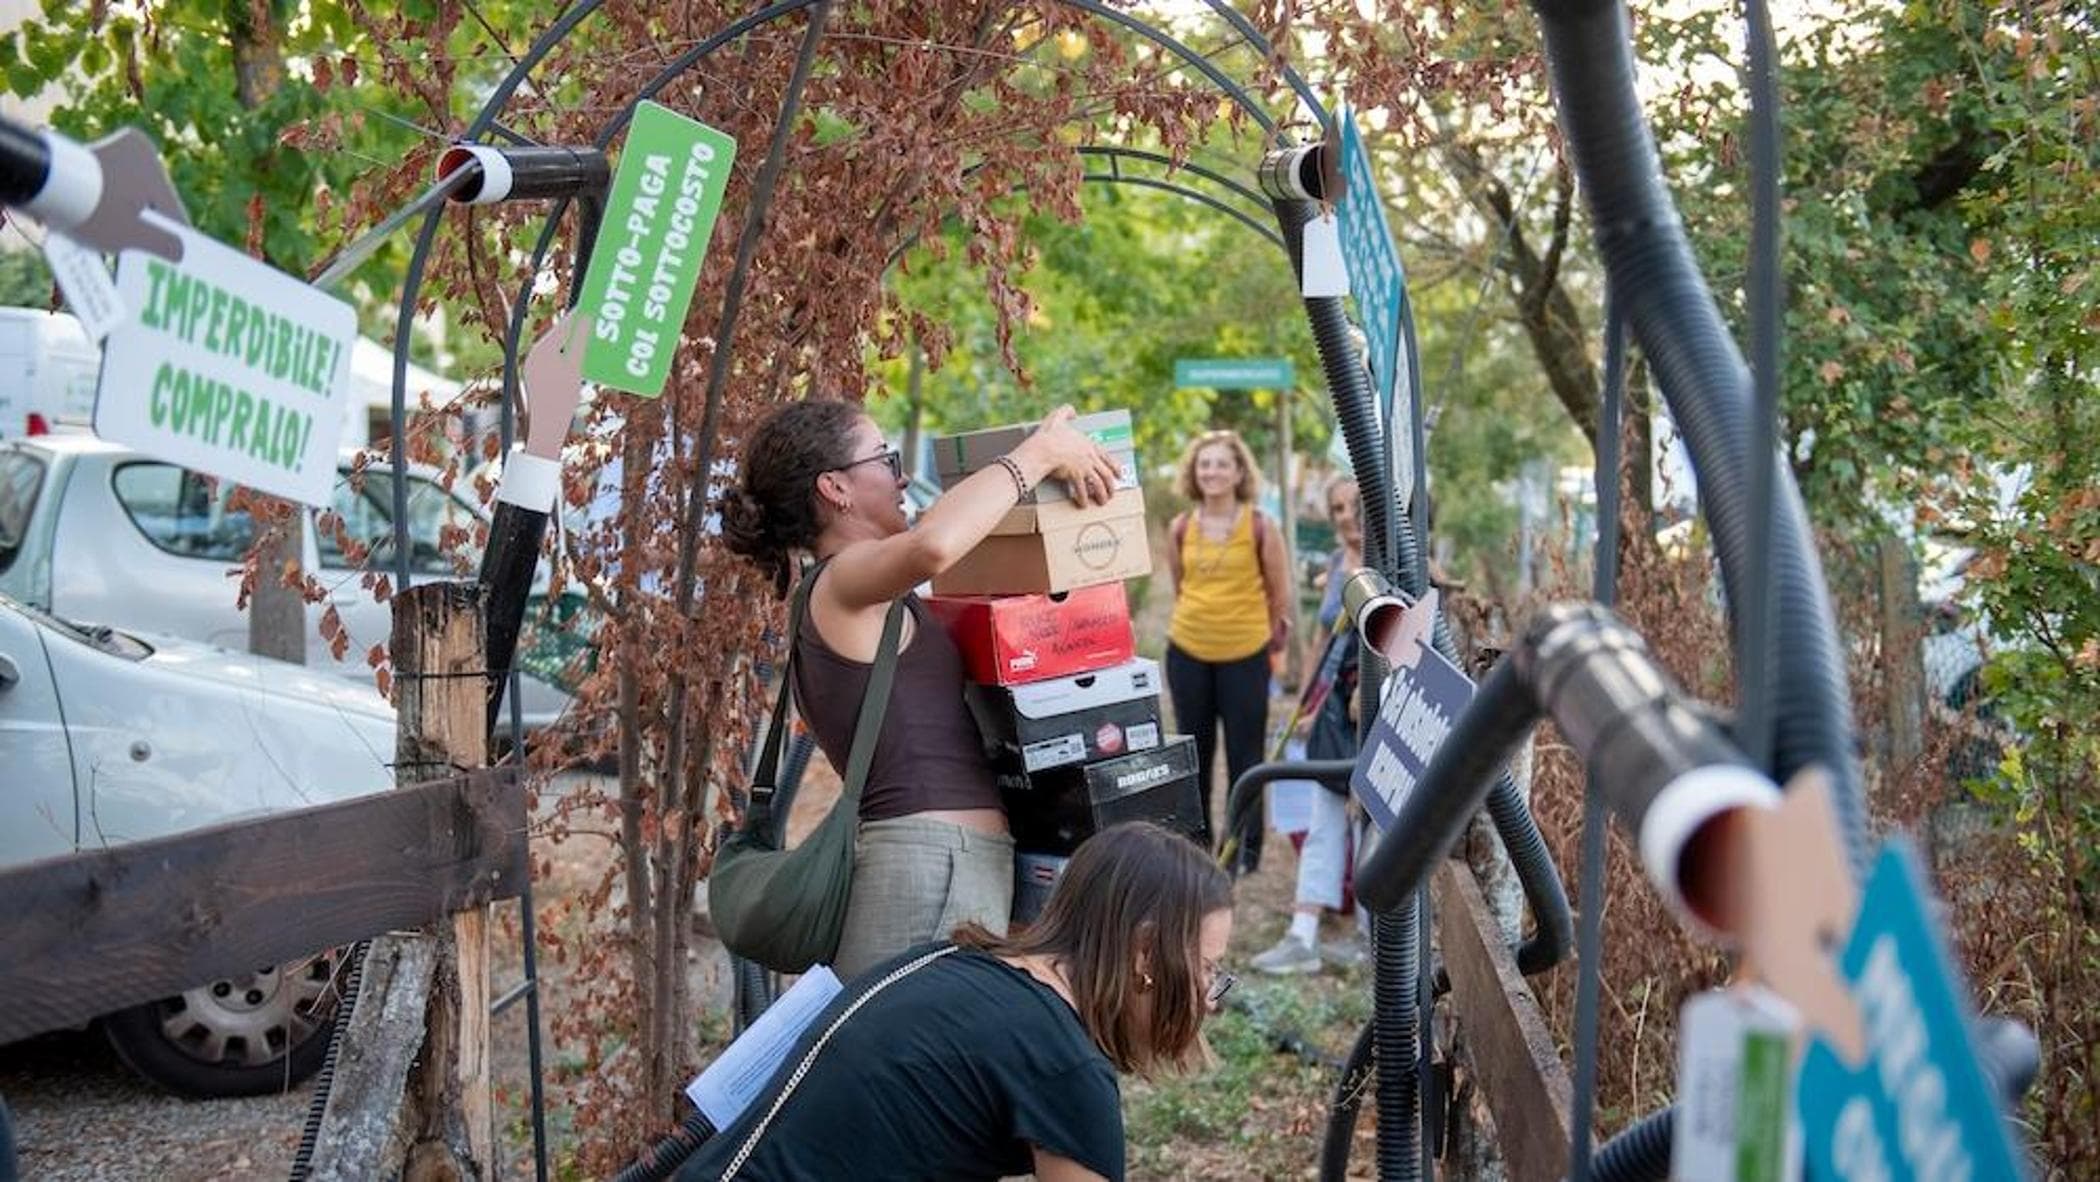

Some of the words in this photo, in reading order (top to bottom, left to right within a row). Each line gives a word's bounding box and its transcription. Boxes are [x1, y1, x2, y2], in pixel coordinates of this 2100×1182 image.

[595, 153, 672, 343] SOTTO-PAGA
[643, 141, 715, 324] SOTTOCOSTO
[150, 364, 313, 473] COMPRALO!
